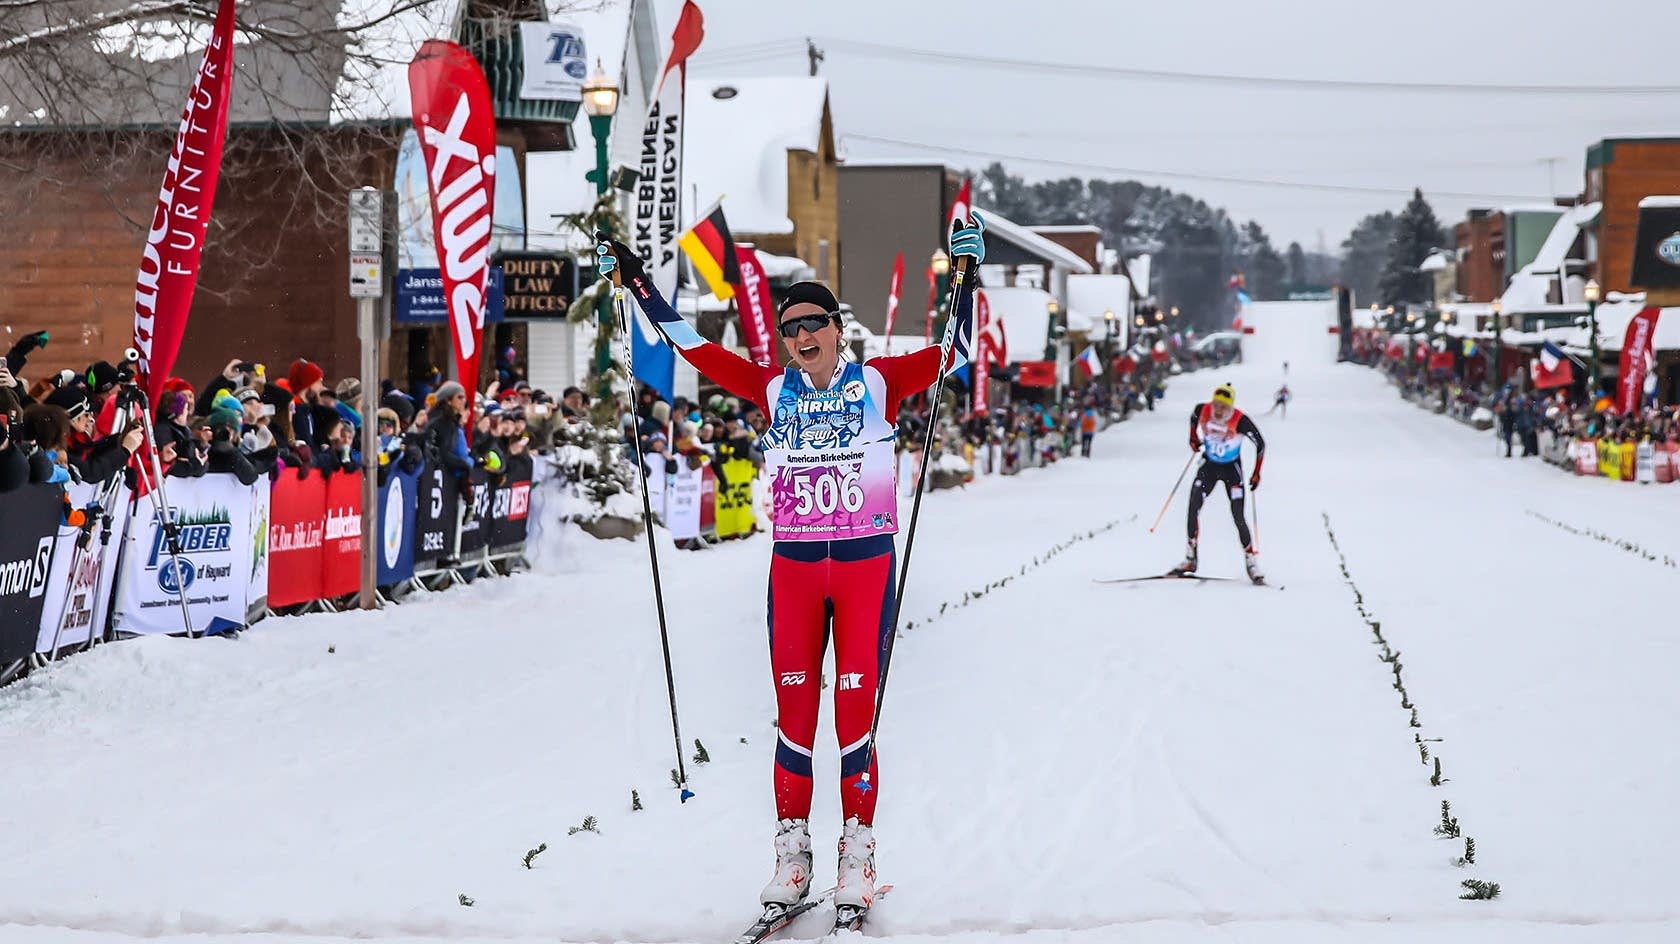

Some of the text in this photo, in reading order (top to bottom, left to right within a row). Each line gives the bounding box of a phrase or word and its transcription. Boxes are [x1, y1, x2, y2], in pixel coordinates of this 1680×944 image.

[167, 35, 222, 275] FURNITURE
[504, 260, 565, 275] DUFFY
[514, 278, 553, 292] LAW
[787, 451, 865, 464] American Birkebeiner
[794, 472, 864, 516] 506
[197, 564, 205, 579] of
[205, 563, 231, 581] Hayward
